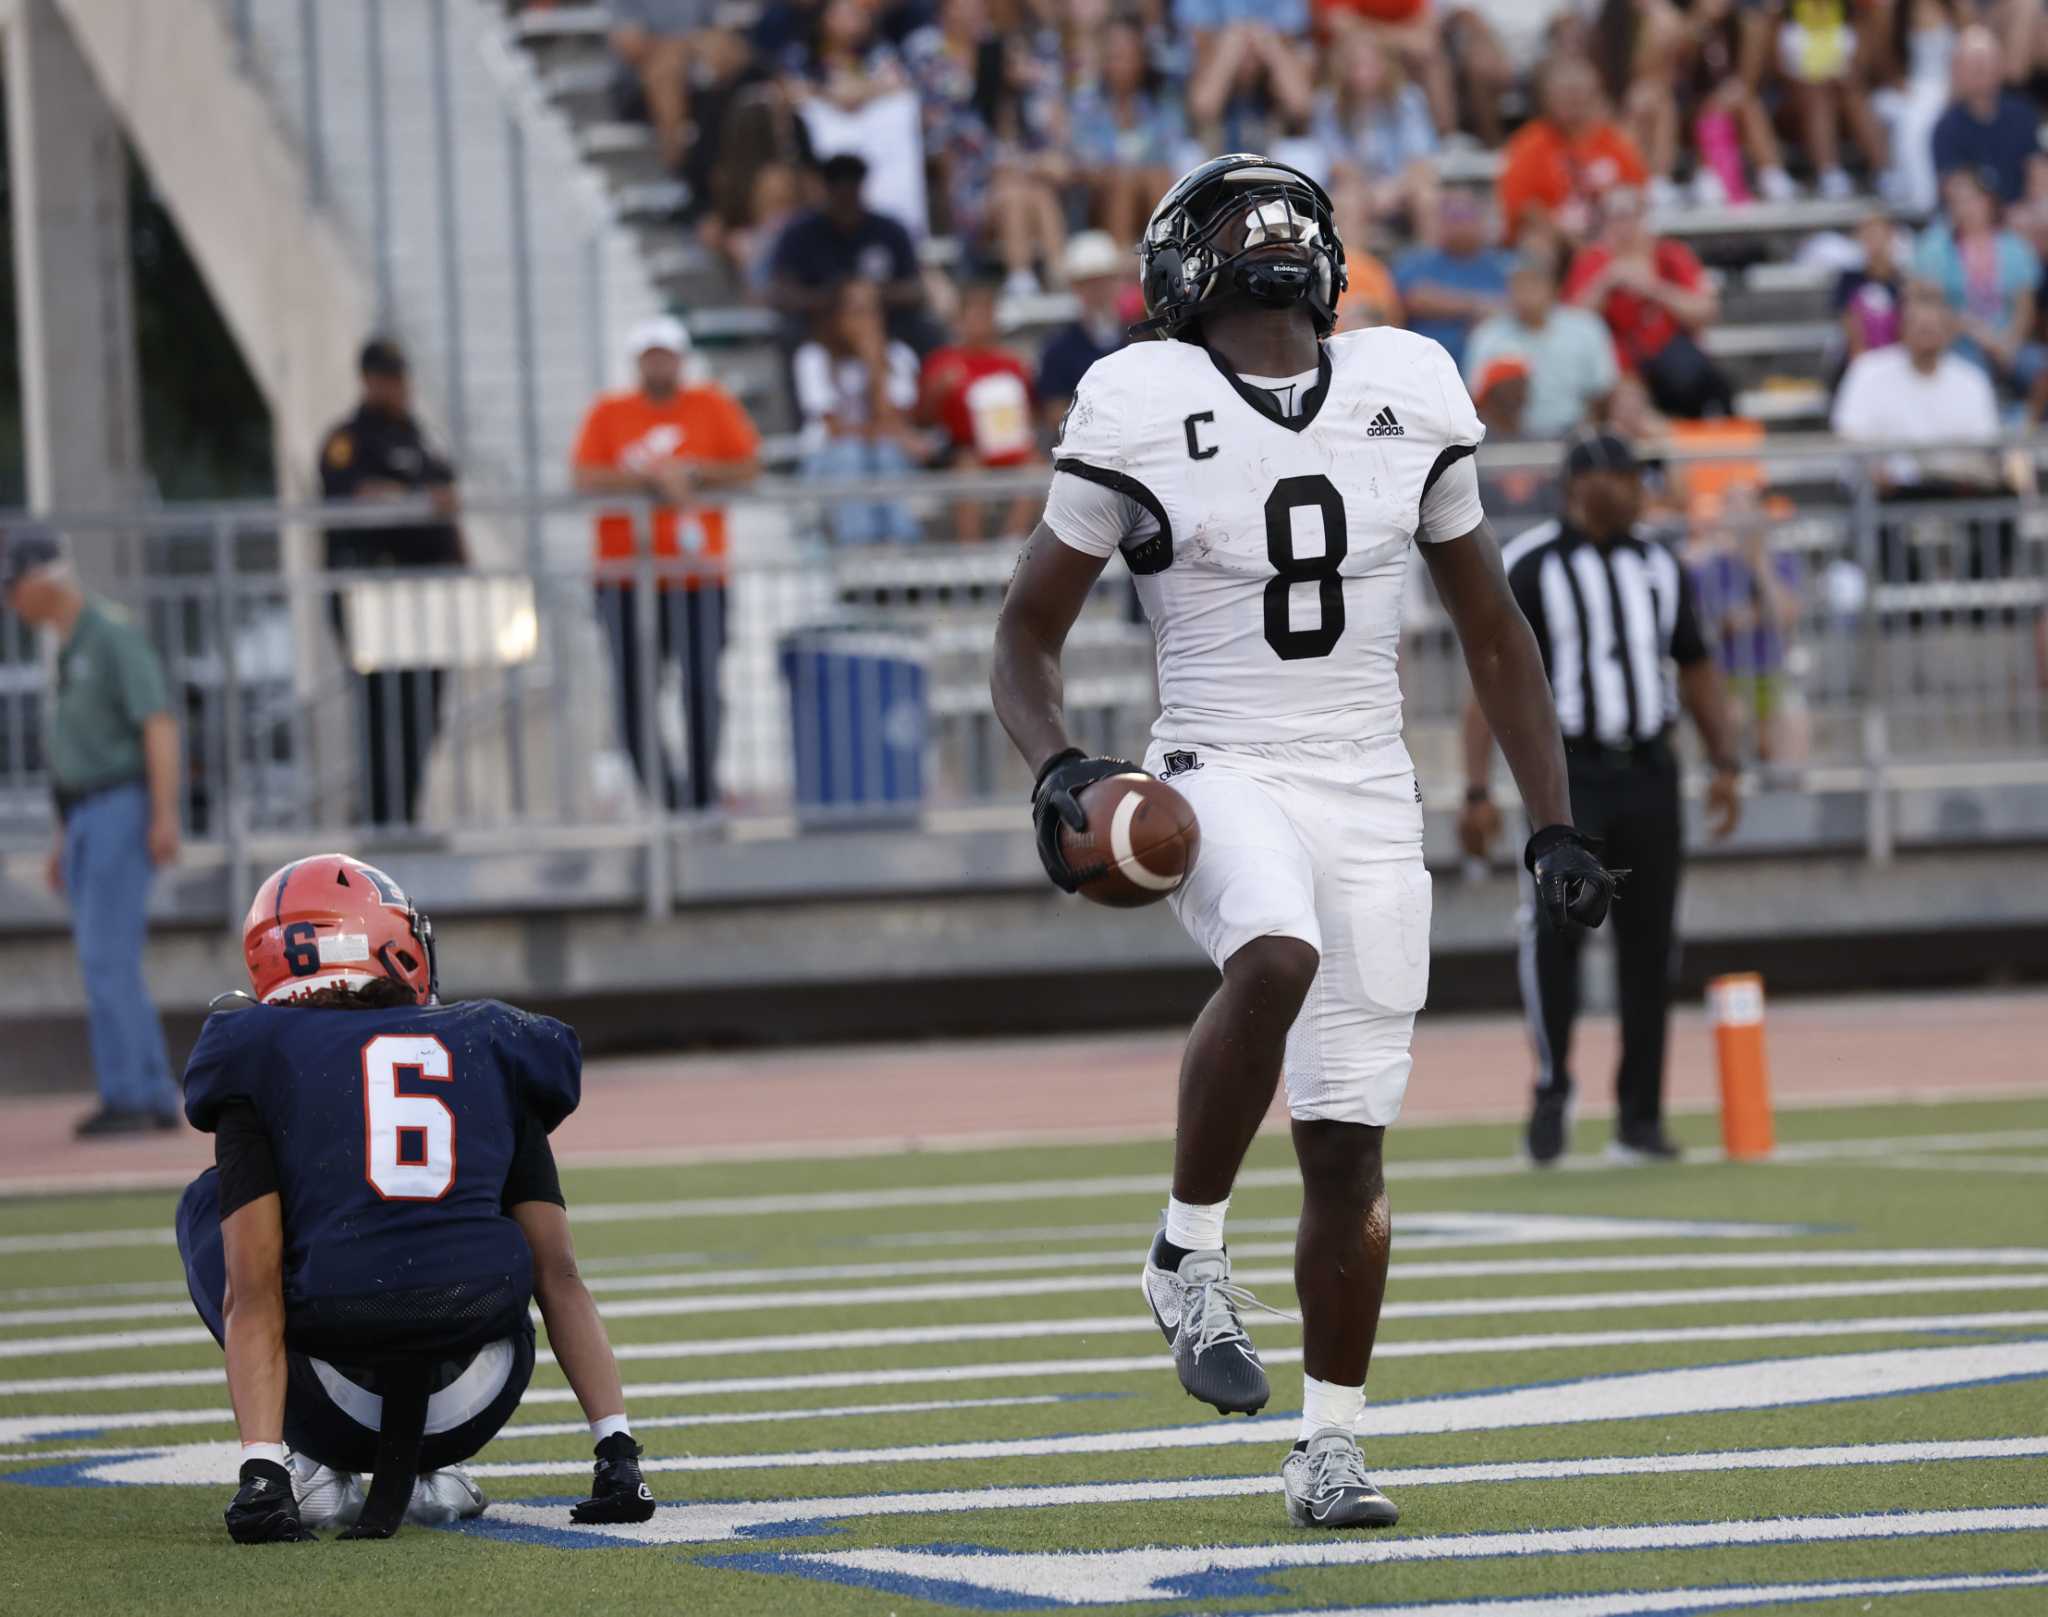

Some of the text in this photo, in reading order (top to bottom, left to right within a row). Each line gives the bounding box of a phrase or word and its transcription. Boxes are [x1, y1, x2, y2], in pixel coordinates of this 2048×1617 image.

[1184, 410, 1220, 461] C
[1366, 424, 1405, 437] adidas
[1263, 473, 1349, 661] 8
[284, 921, 320, 977] 6
[361, 1033, 456, 1200] 6
